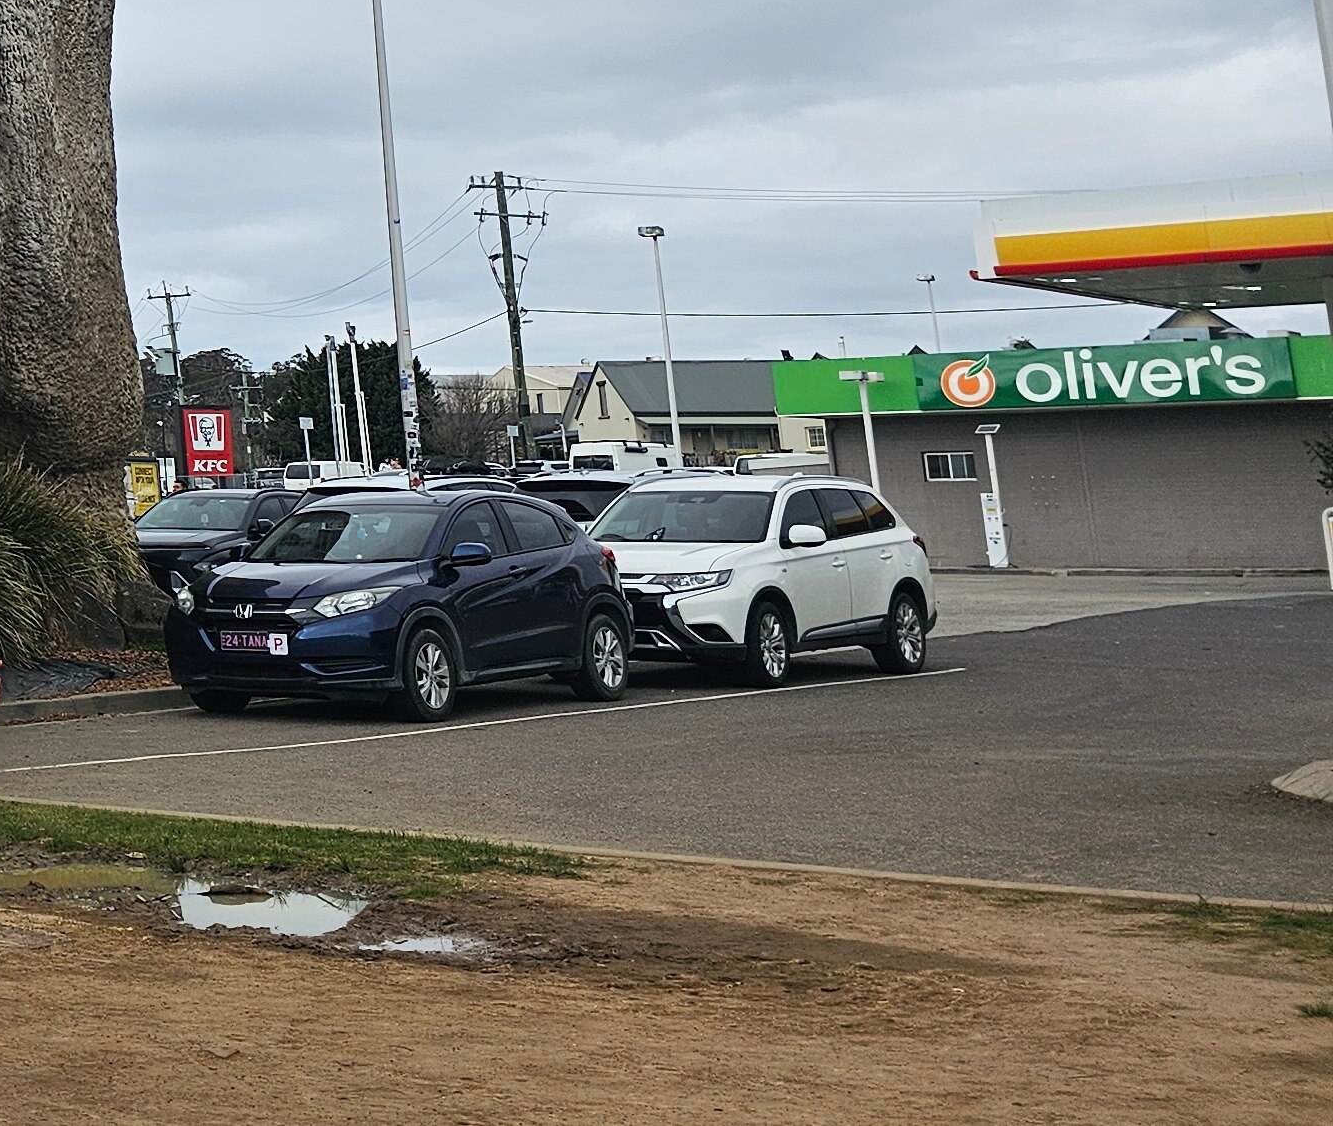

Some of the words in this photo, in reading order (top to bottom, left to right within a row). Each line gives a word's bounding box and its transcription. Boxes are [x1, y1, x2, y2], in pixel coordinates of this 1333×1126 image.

[1014, 344, 1267, 404] oliver's
[192, 459, 228, 473] KFC
[274, 638, 283, 651] P
